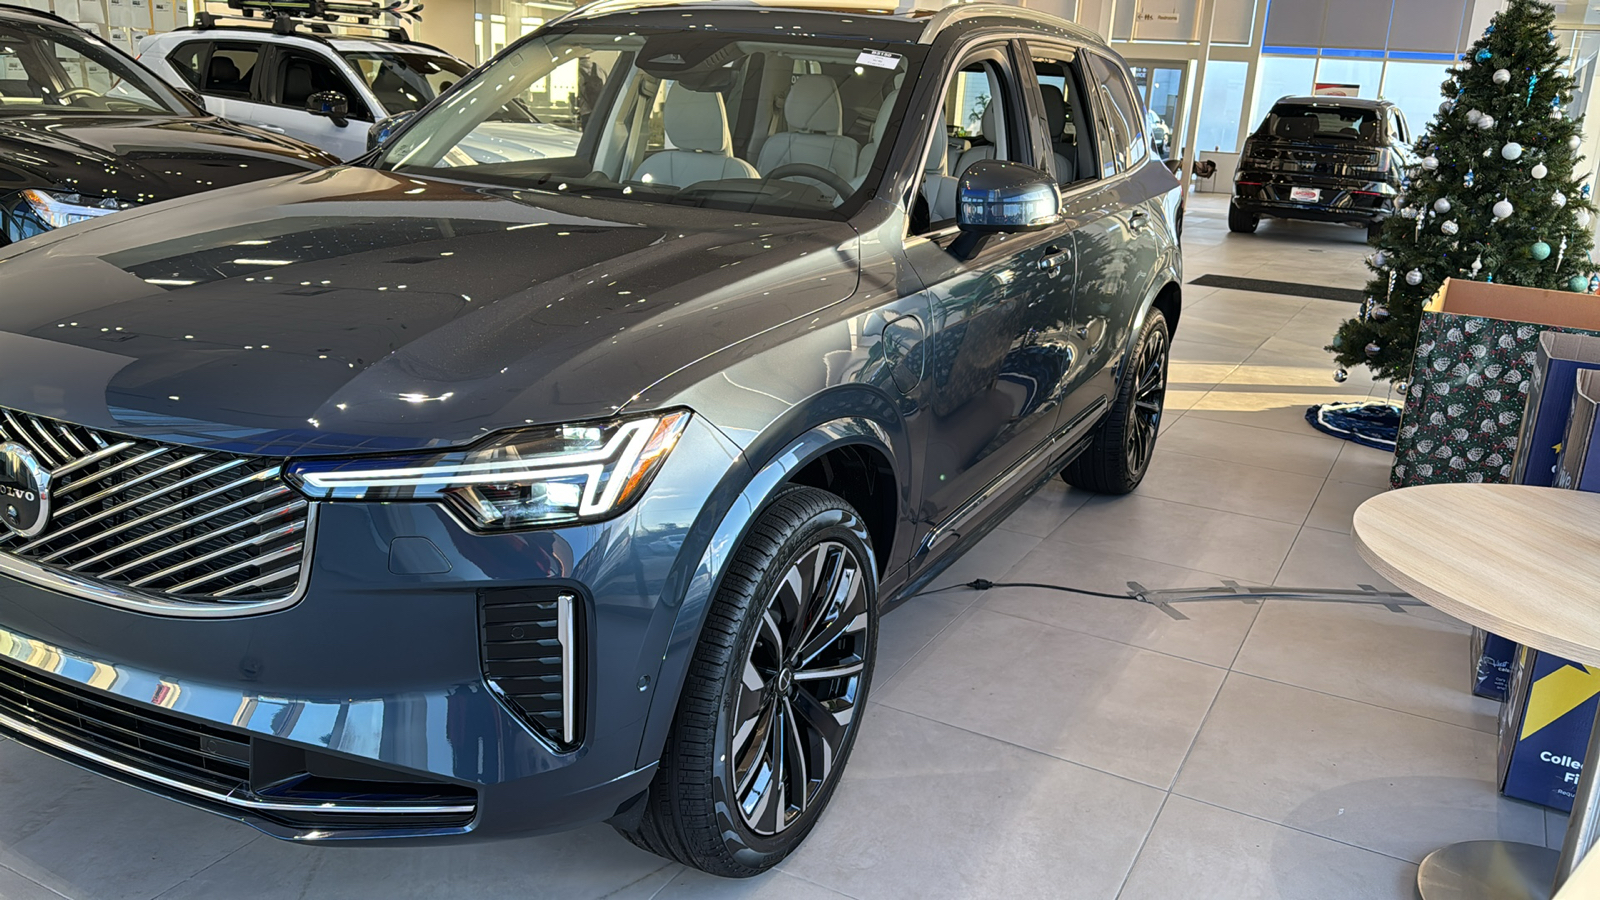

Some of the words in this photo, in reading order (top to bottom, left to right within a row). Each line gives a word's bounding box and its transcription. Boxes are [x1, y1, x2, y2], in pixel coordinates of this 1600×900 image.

[0, 484, 34, 501] OLVO
[1564, 772, 1580, 784] Fi
[1558, 788, 1576, 798] Requ
